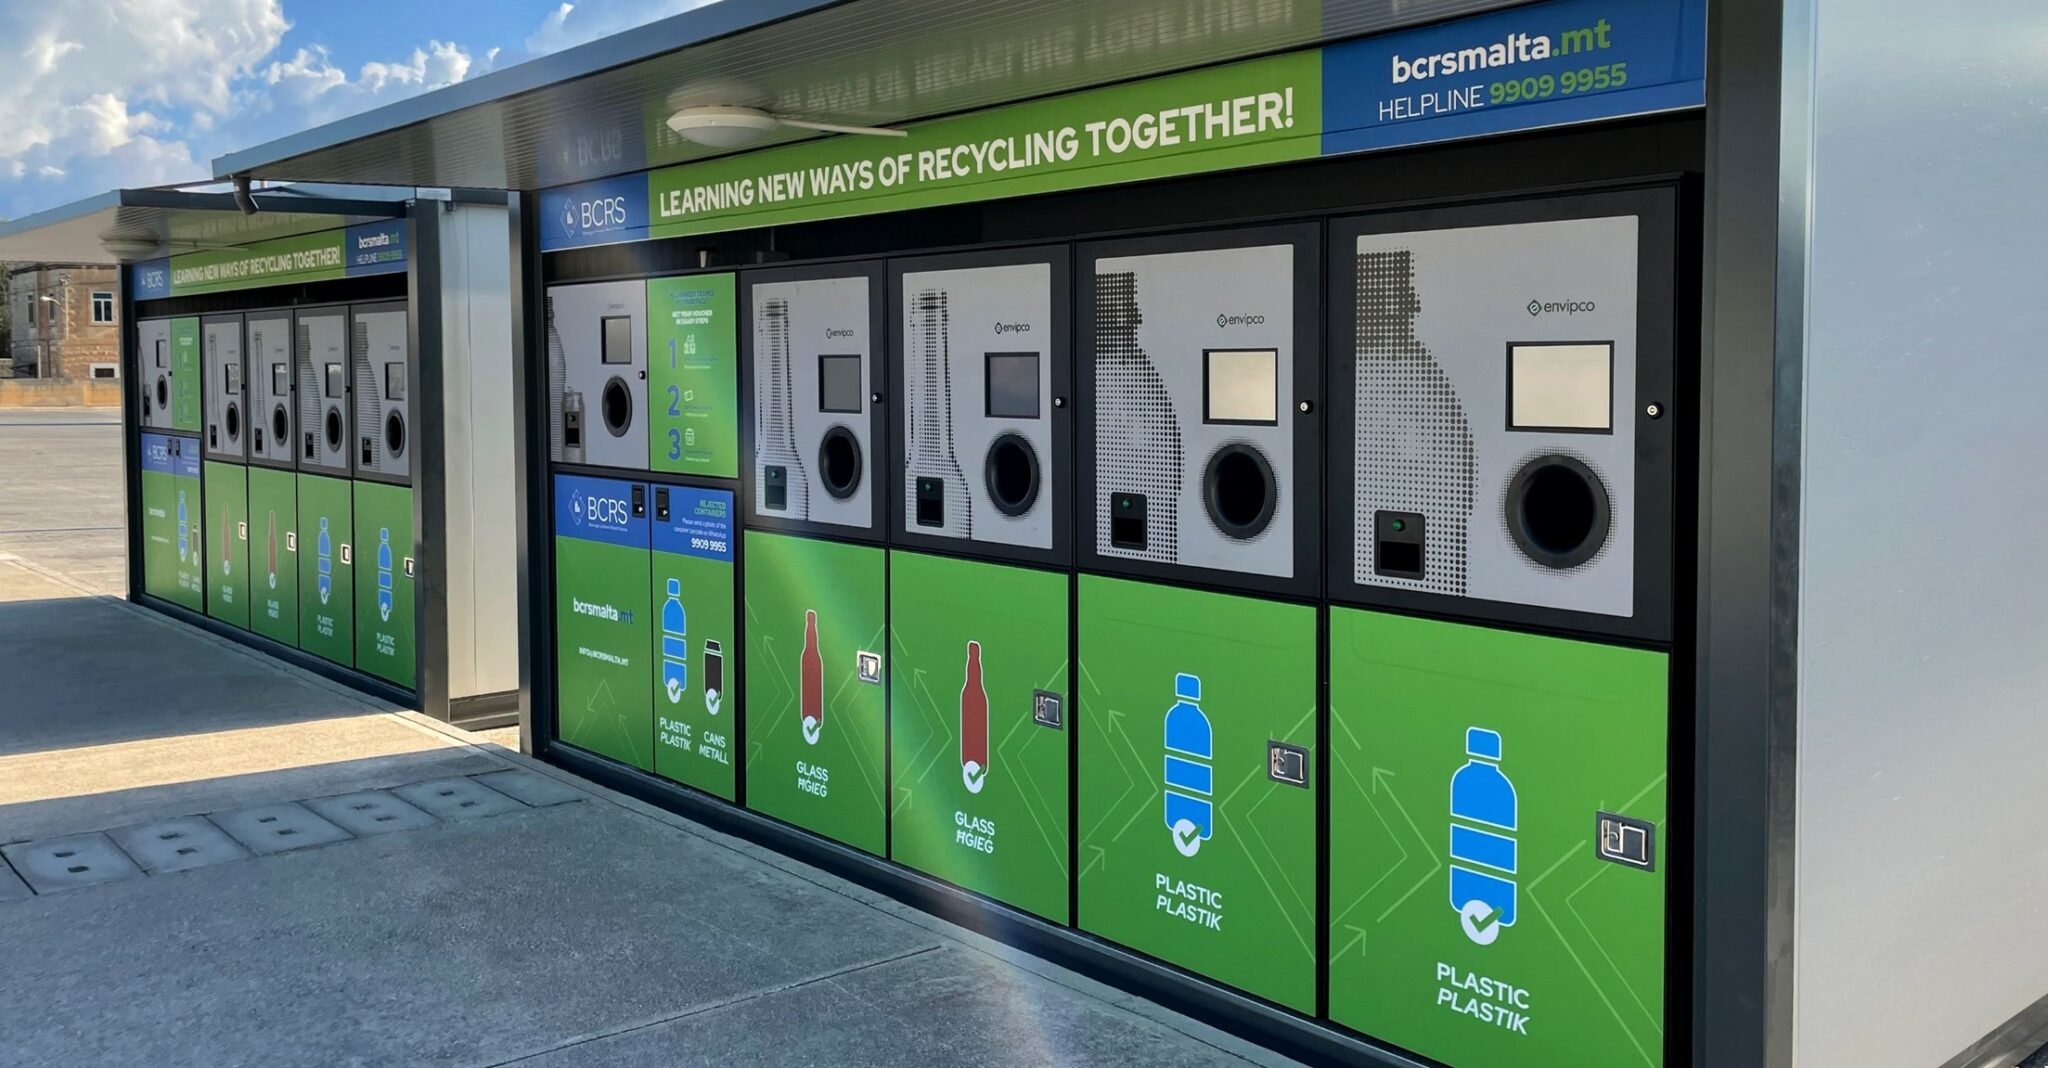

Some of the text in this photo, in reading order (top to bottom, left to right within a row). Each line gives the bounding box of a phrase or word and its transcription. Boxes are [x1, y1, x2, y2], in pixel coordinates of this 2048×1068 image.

[1391, 18, 1611, 84] bcrsmalta.mt
[1379, 63, 1627, 122] HELPLINE 9909 9955
[660, 87, 1294, 217] LEARNING NEW WAYS OF RECYCLING TOGETHER!
[581, 197, 626, 228] BCRS
[173, 246, 341, 285] LEARNING NEW WAYS OF RECYCLING TOGETHER!
[147, 271, 163, 289] BCRS
[1228, 313, 1265, 327] envipco
[1544, 298, 1596, 316] envipco
[832, 328, 854, 339] envipco
[1003, 321, 1030, 334] envipco
[667, 337, 677, 369] 1
[667, 385, 681, 416] 2
[668, 428, 681, 460] 3
[587, 496, 628, 525] BCRS
[694, 508, 727, 518] CONTAINERS
[699, 500, 727, 510] REJECTED
[691, 538, 727, 552] 9909 9955
[573, 597, 634, 624] bcrsmalta.mt
[660, 716, 692, 738] PLASTIC
[703, 731, 726, 749] CANS
[660, 732, 692, 752] PLASTIK
[699, 743, 729, 765] METALL
[796, 760, 829, 782] GLASS
[954, 811, 996, 837] GLASS
[1155, 873, 1223, 909] PLASTIC
[1156, 895, 1224, 931] PLASTIK
[1436, 962, 1531, 1011] PLASTIC
[1436, 988, 1532, 1036] PLASTIK
